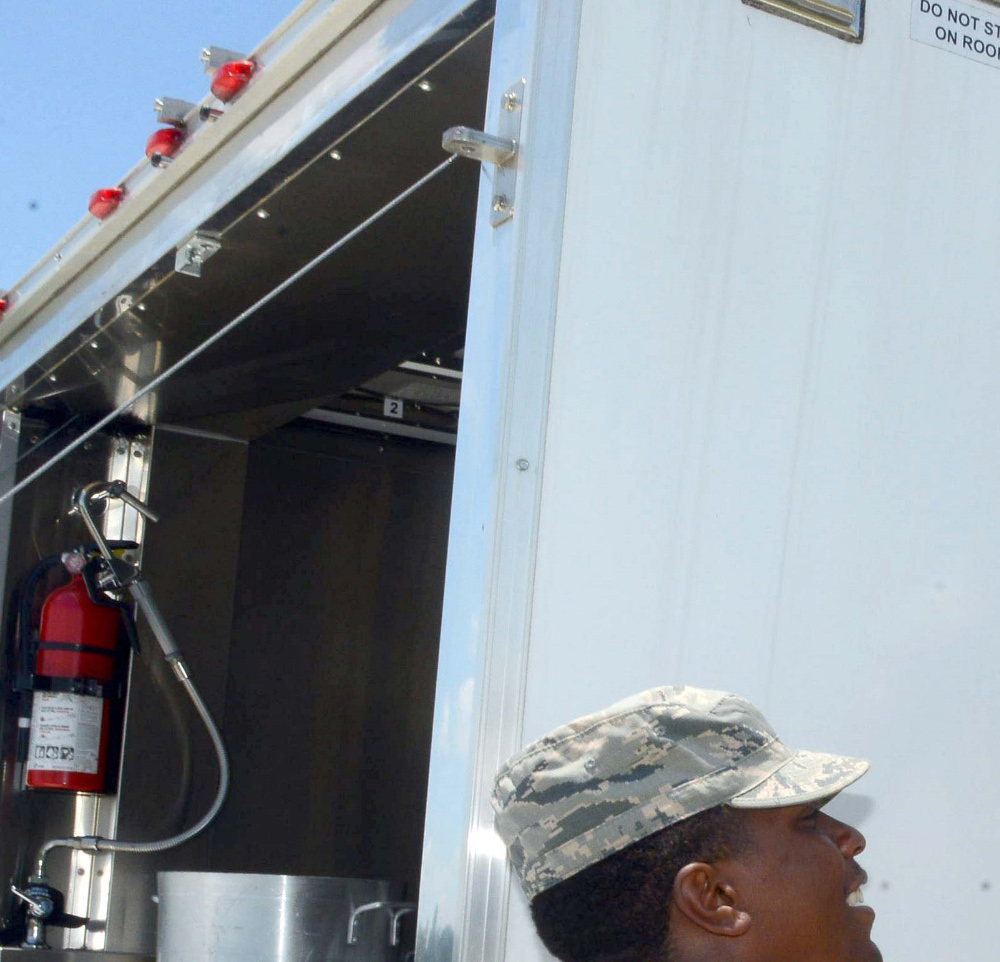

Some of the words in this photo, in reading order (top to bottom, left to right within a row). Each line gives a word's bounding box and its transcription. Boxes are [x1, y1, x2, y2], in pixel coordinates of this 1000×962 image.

[920, 0, 942, 17] DO
[948, 8, 980, 31] NOT
[935, 26, 957, 45] ON
[390, 402, 398, 414] 2
